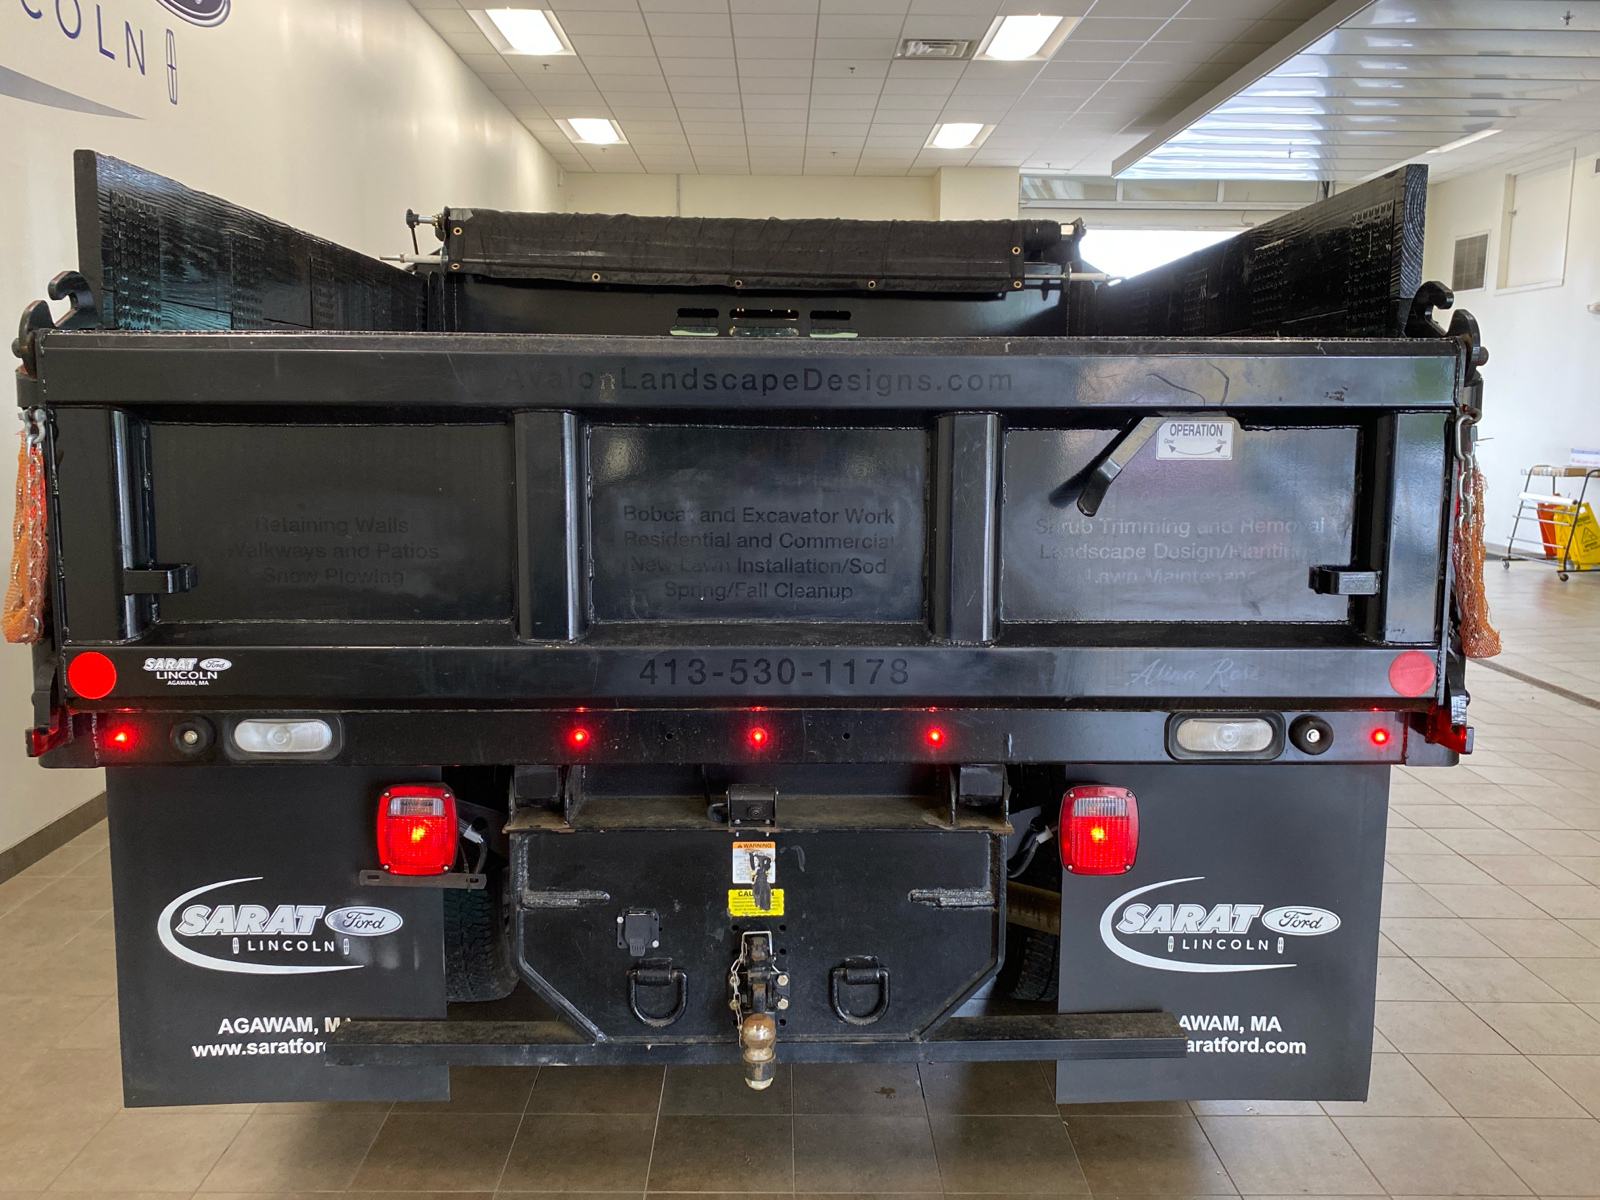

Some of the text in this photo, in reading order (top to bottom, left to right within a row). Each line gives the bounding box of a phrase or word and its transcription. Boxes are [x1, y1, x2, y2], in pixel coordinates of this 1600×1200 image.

[1169, 423, 1223, 437] OPERATION
[700, 506, 735, 523] and
[743, 507, 840, 524] Excavator
[845, 508, 895, 525] Work
[354, 517, 409, 534] Walls
[1099, 517, 1191, 538] Trimming
[1197, 519, 1233, 534] and
[1241, 517, 1325, 534] Remoal
[624, 531, 895, 549] Residential and Commercial
[228, 542, 439, 561] Walkways and Patios
[1040, 542, 1146, 563] Landscape
[631, 557, 671, 573] New
[737, 557, 887, 575] Installation/Sod
[263, 566, 404, 588] Snow Plowing
[664, 581, 853, 601] Spring/Fall Cleanup
[143, 657, 198, 671] SARAT
[639, 658, 909, 685] 413-530-1178
[156, 671, 218, 680] LINCOLN
[1202, 657, 1260, 693] Rose
[175, 904, 326, 936] SARAT
[1116, 903, 1264, 934] SARAT
[248, 940, 335, 952] LINCOLN
[1182, 939, 1269, 950] LINCOLN
[218, 1017, 352, 1035] AGAWAM, M
[1178, 1015, 1282, 1034] AWAM, MA
[192, 1037, 326, 1058] www.saratfor
[1187, 1036, 1306, 1055] aratford.com
